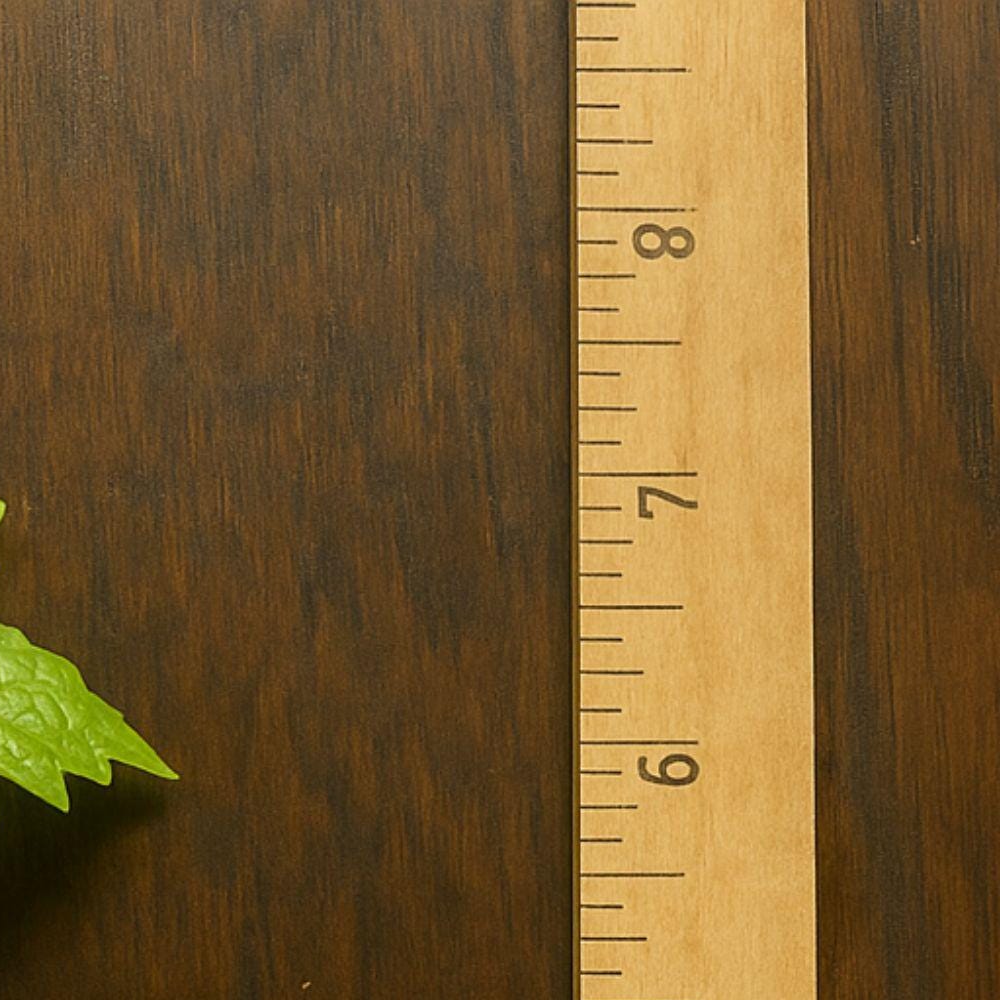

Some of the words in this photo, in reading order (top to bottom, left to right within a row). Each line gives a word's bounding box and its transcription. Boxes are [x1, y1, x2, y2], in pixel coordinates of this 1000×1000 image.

[633, 224, 694, 259] 8
[638, 487, 698, 518] 7
[638, 754, 699, 786] 6
